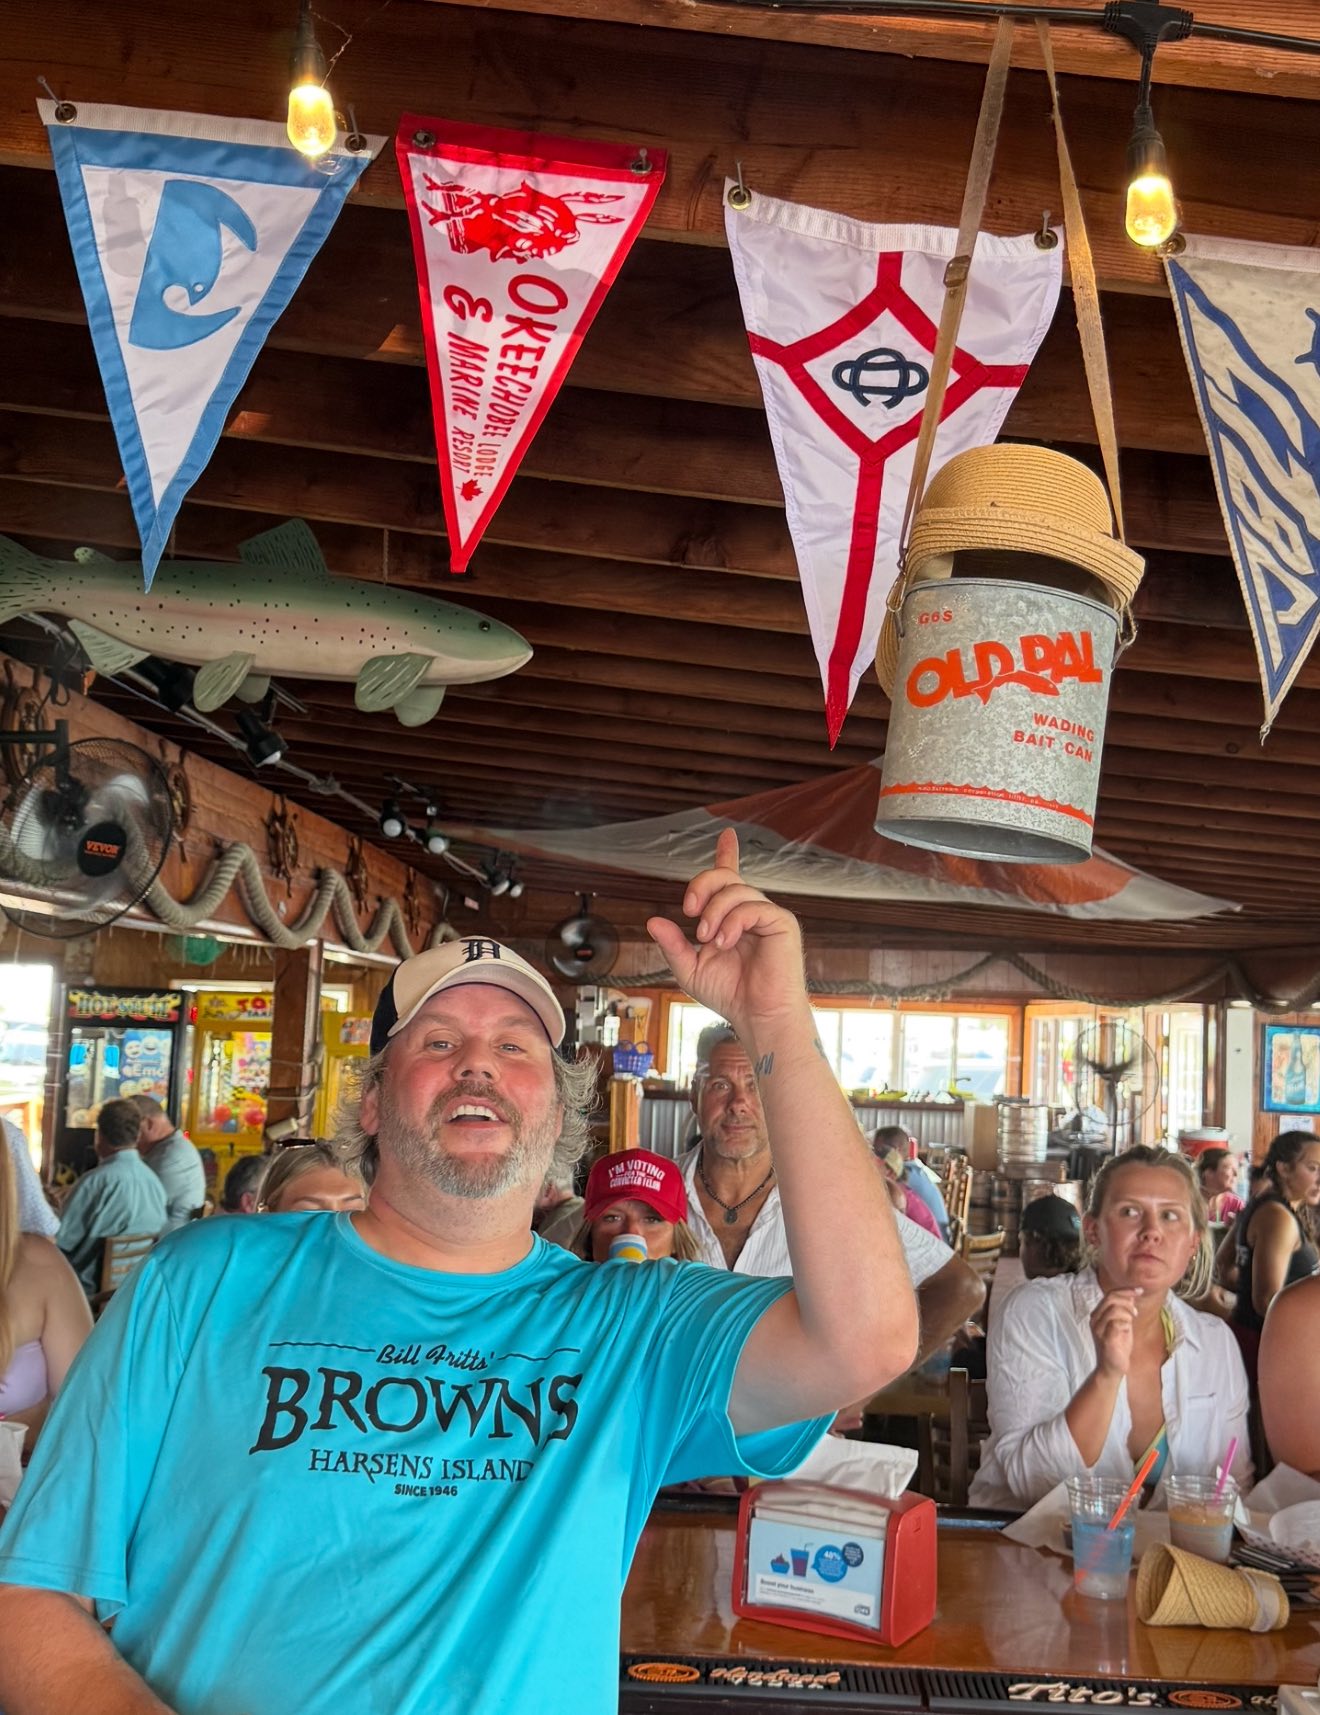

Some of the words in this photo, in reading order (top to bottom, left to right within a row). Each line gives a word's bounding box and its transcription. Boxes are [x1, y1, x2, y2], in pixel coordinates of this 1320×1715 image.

[443, 284, 493, 324] &
[482, 274, 568, 439] OKEECHOBEE
[447, 331, 490, 421] MARINE
[450, 425, 475, 474] RESORT
[474, 443, 502, 477] LODGE
[905, 640, 1015, 708] OLD
[1019, 631, 1103, 683] PAL
[1033, 712, 1095, 742] WADING
[1013, 730, 1056, 750] BAIT
[1064, 742, 1093, 763] CAN
[86, 840, 119, 855] VEVOR
[608, 1161, 625, 1178] I'M
[627, 1159, 666, 1181] VOTING
[376, 1343, 421, 1365] Bill
[249, 1366, 583, 1456] BROWNS
[308, 1448, 433, 1484] HARSENS
[440, 1458, 534, 1483] ISLAND
[394, 1483, 427, 1497] SINCE
[429, 1485, 459, 1497] 1946
[1008, 1682, 1157, 1707] Tito's
